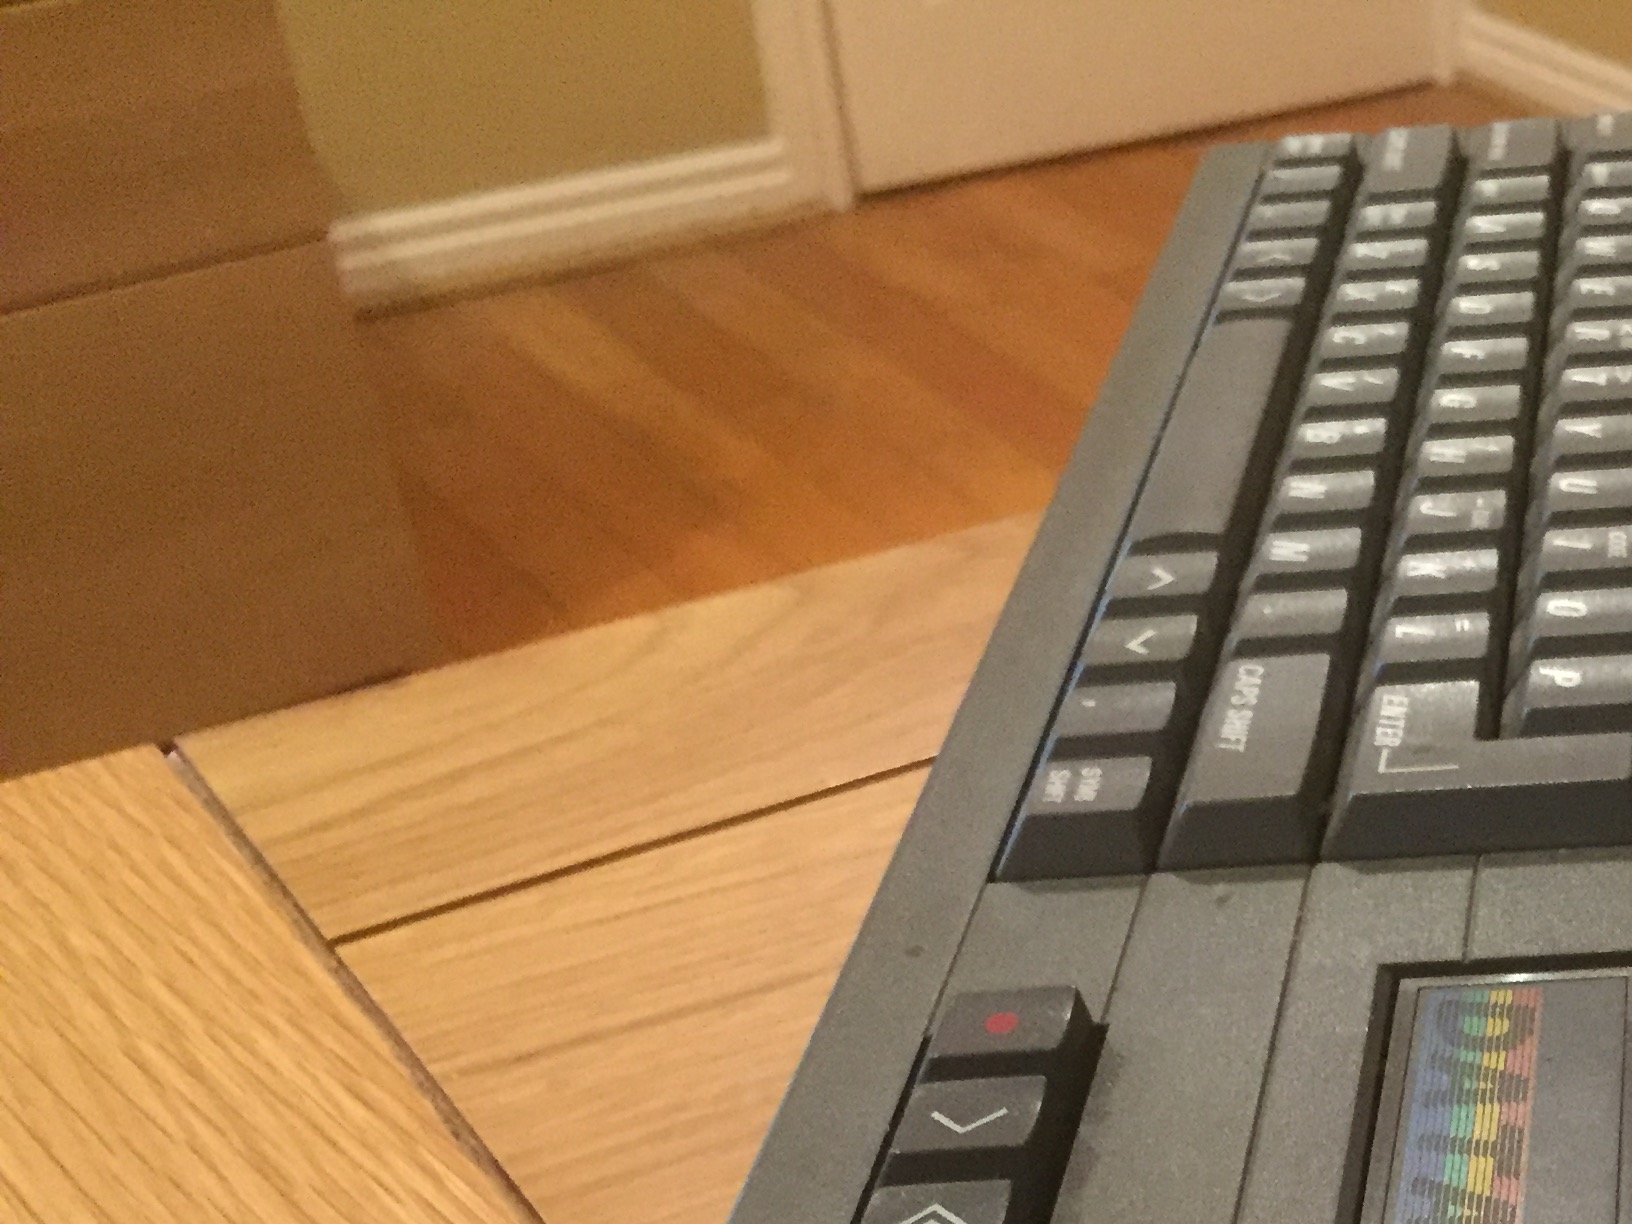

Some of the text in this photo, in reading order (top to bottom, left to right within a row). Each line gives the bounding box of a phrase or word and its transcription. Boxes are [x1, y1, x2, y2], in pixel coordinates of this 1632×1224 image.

[1320, 376, 1355, 391] V
[1571, 373, 1607, 386] T
[1563, 423, 1602, 438] Y
[1559, 477, 1598, 494] U
[1420, 501, 1457, 517] J
[1269, 540, 1310, 561] M
[1407, 559, 1445, 578] K
[1395, 625, 1436, 638] L
[1539, 666, 1583, 688] P
[1216, 665, 1264, 753] CAPS SHIFT
[1374, 694, 1408, 747] ENTER
